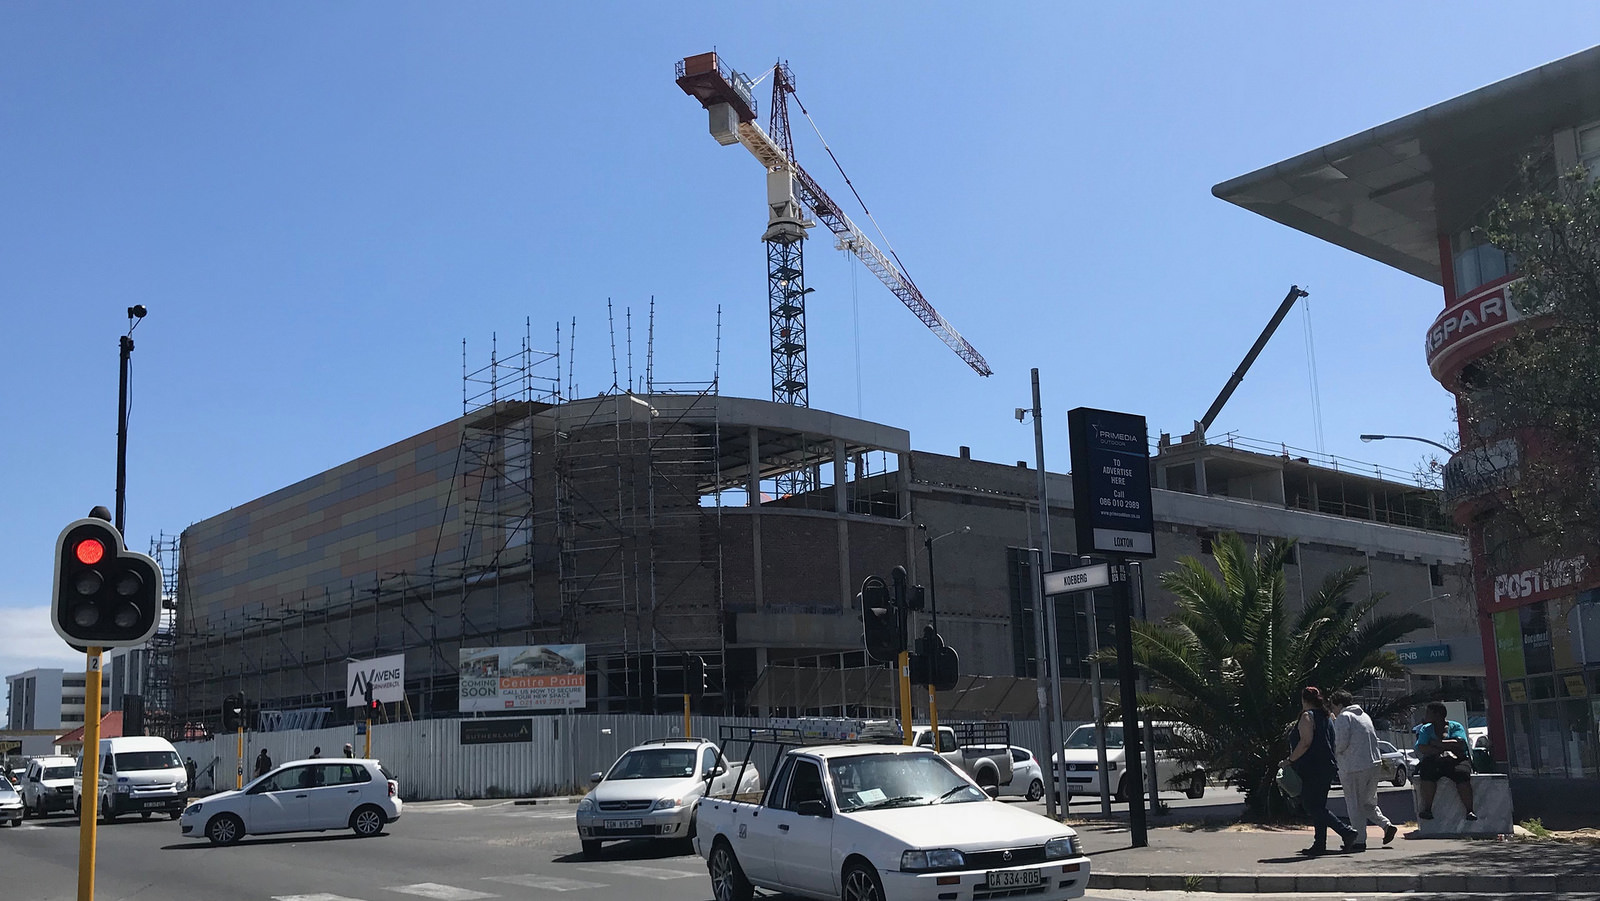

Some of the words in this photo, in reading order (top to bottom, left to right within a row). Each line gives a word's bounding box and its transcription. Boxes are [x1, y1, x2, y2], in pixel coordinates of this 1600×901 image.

[1099, 430, 1138, 442] PRIMEDIA
[1100, 438, 1126, 447] OUTDOOR
[1112, 458, 1121, 467] TO
[1102, 466, 1133, 477] ADVERTISE
[1111, 476, 1126, 486] HERE
[1113, 489, 1125, 498] Call
[1099, 497, 1112, 506] 086
[1112, 499, 1124, 508] 010
[1113, 536, 1134, 548] LOXTON
[1063, 573, 1088, 586] KOEBERG
[1399, 651, 1418, 661] FNB
[1430, 650, 1445, 658] ATM
[92, 658, 98, 670] 2
[374, 668, 400, 682] AVENG
[461, 679, 497, 688] COMING
[501, 677, 544, 688] Centre
[550, 675, 584, 687] Point
[461, 687, 497, 698] SOON
[990, 873, 1001, 886] CA
[1003, 871, 1039, 885] 334-805
